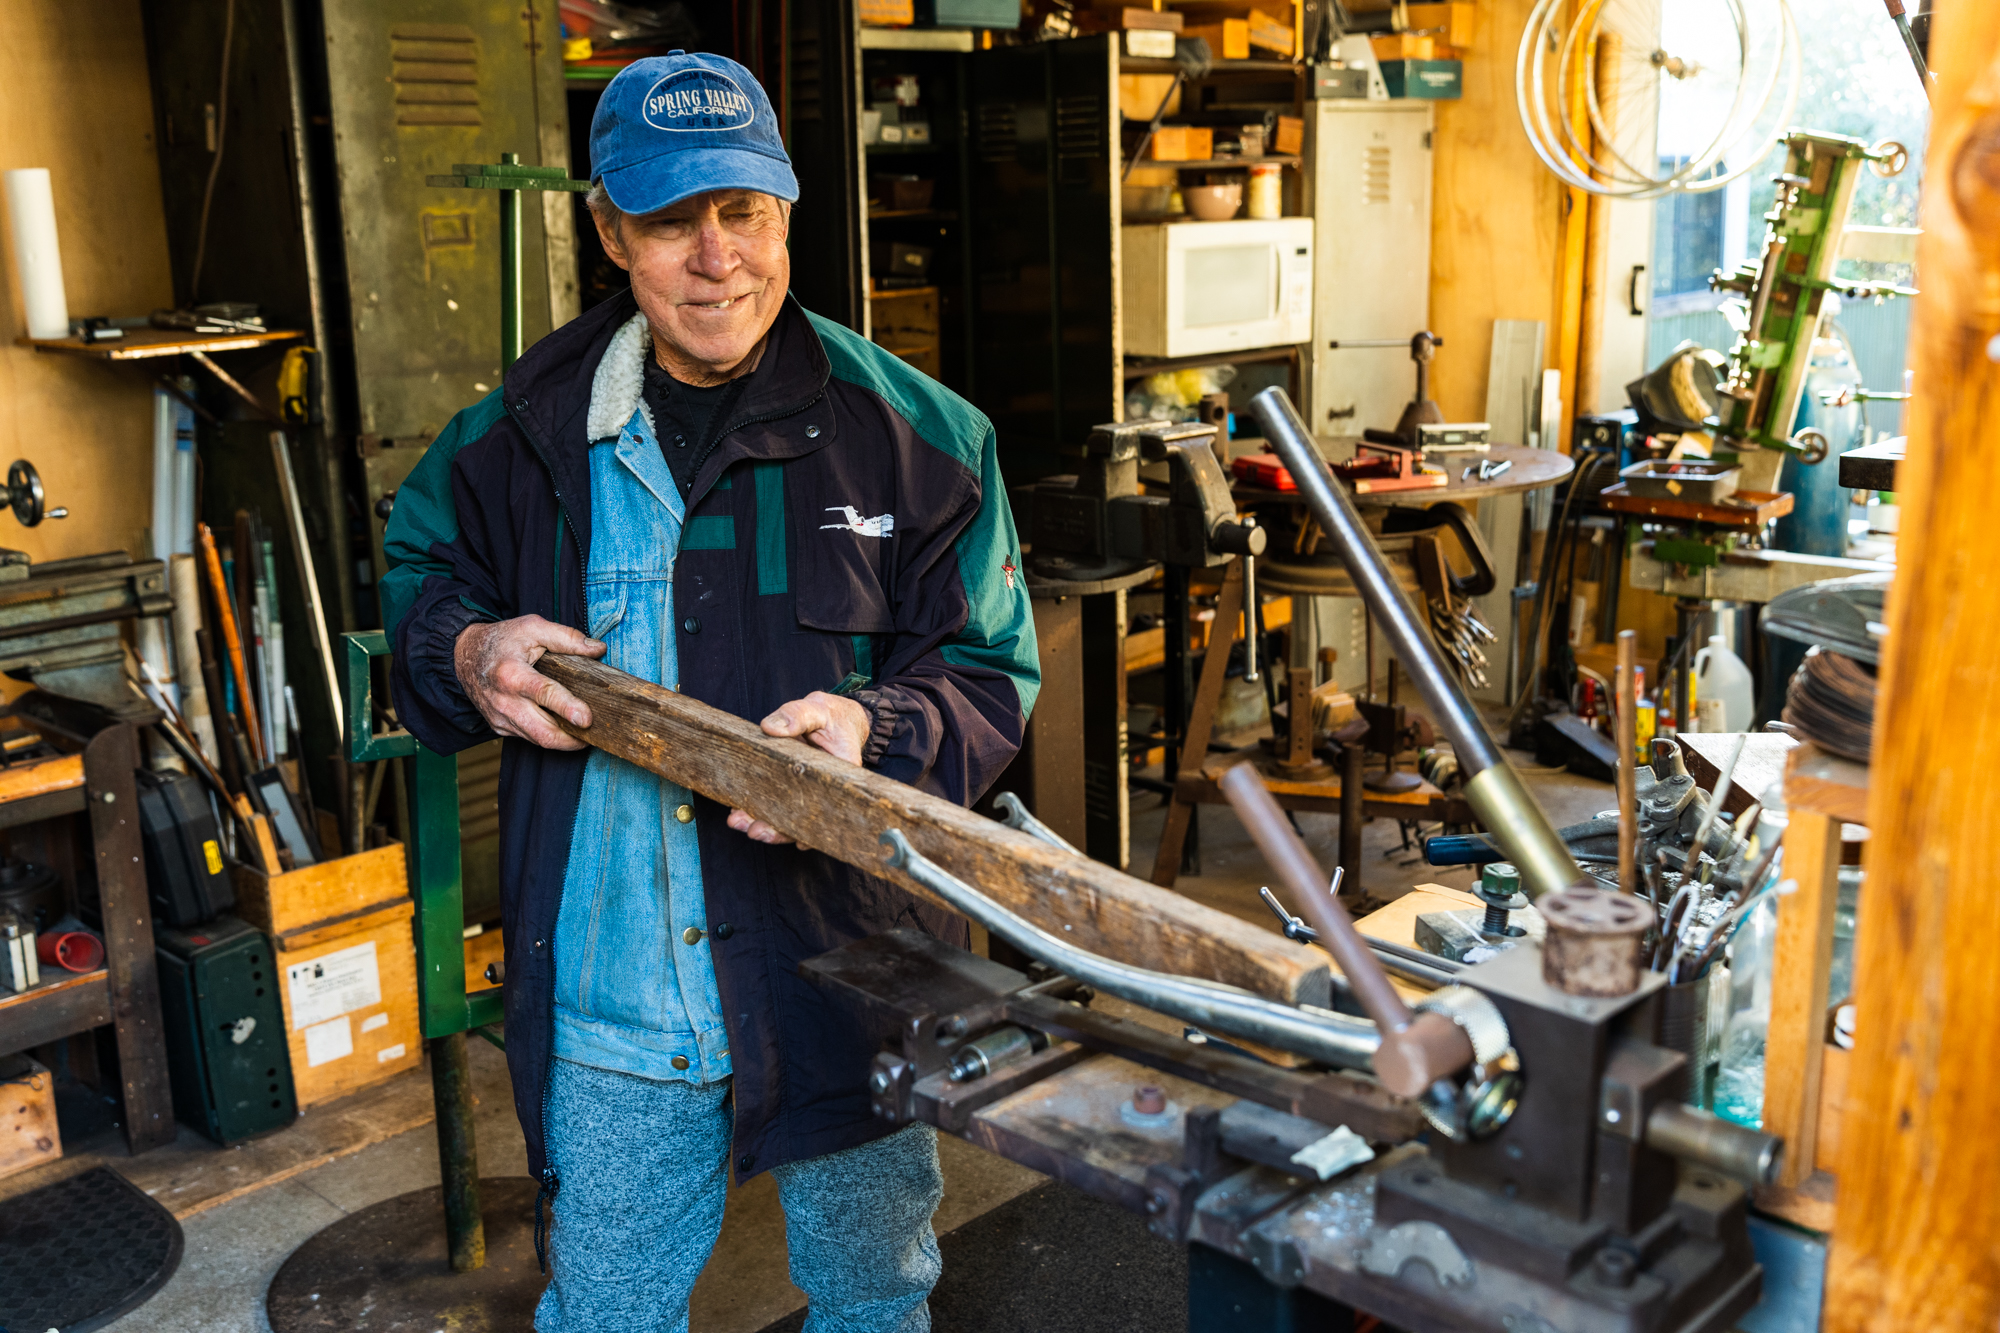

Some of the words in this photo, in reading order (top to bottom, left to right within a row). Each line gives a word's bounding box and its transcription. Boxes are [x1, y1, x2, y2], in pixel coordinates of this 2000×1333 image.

[660, 72, 700, 92] AMERICAN
[649, 89, 701, 116] SPRING
[704, 88, 748, 112] VALLEY
[667, 106, 737, 118] CALIFORNIA
